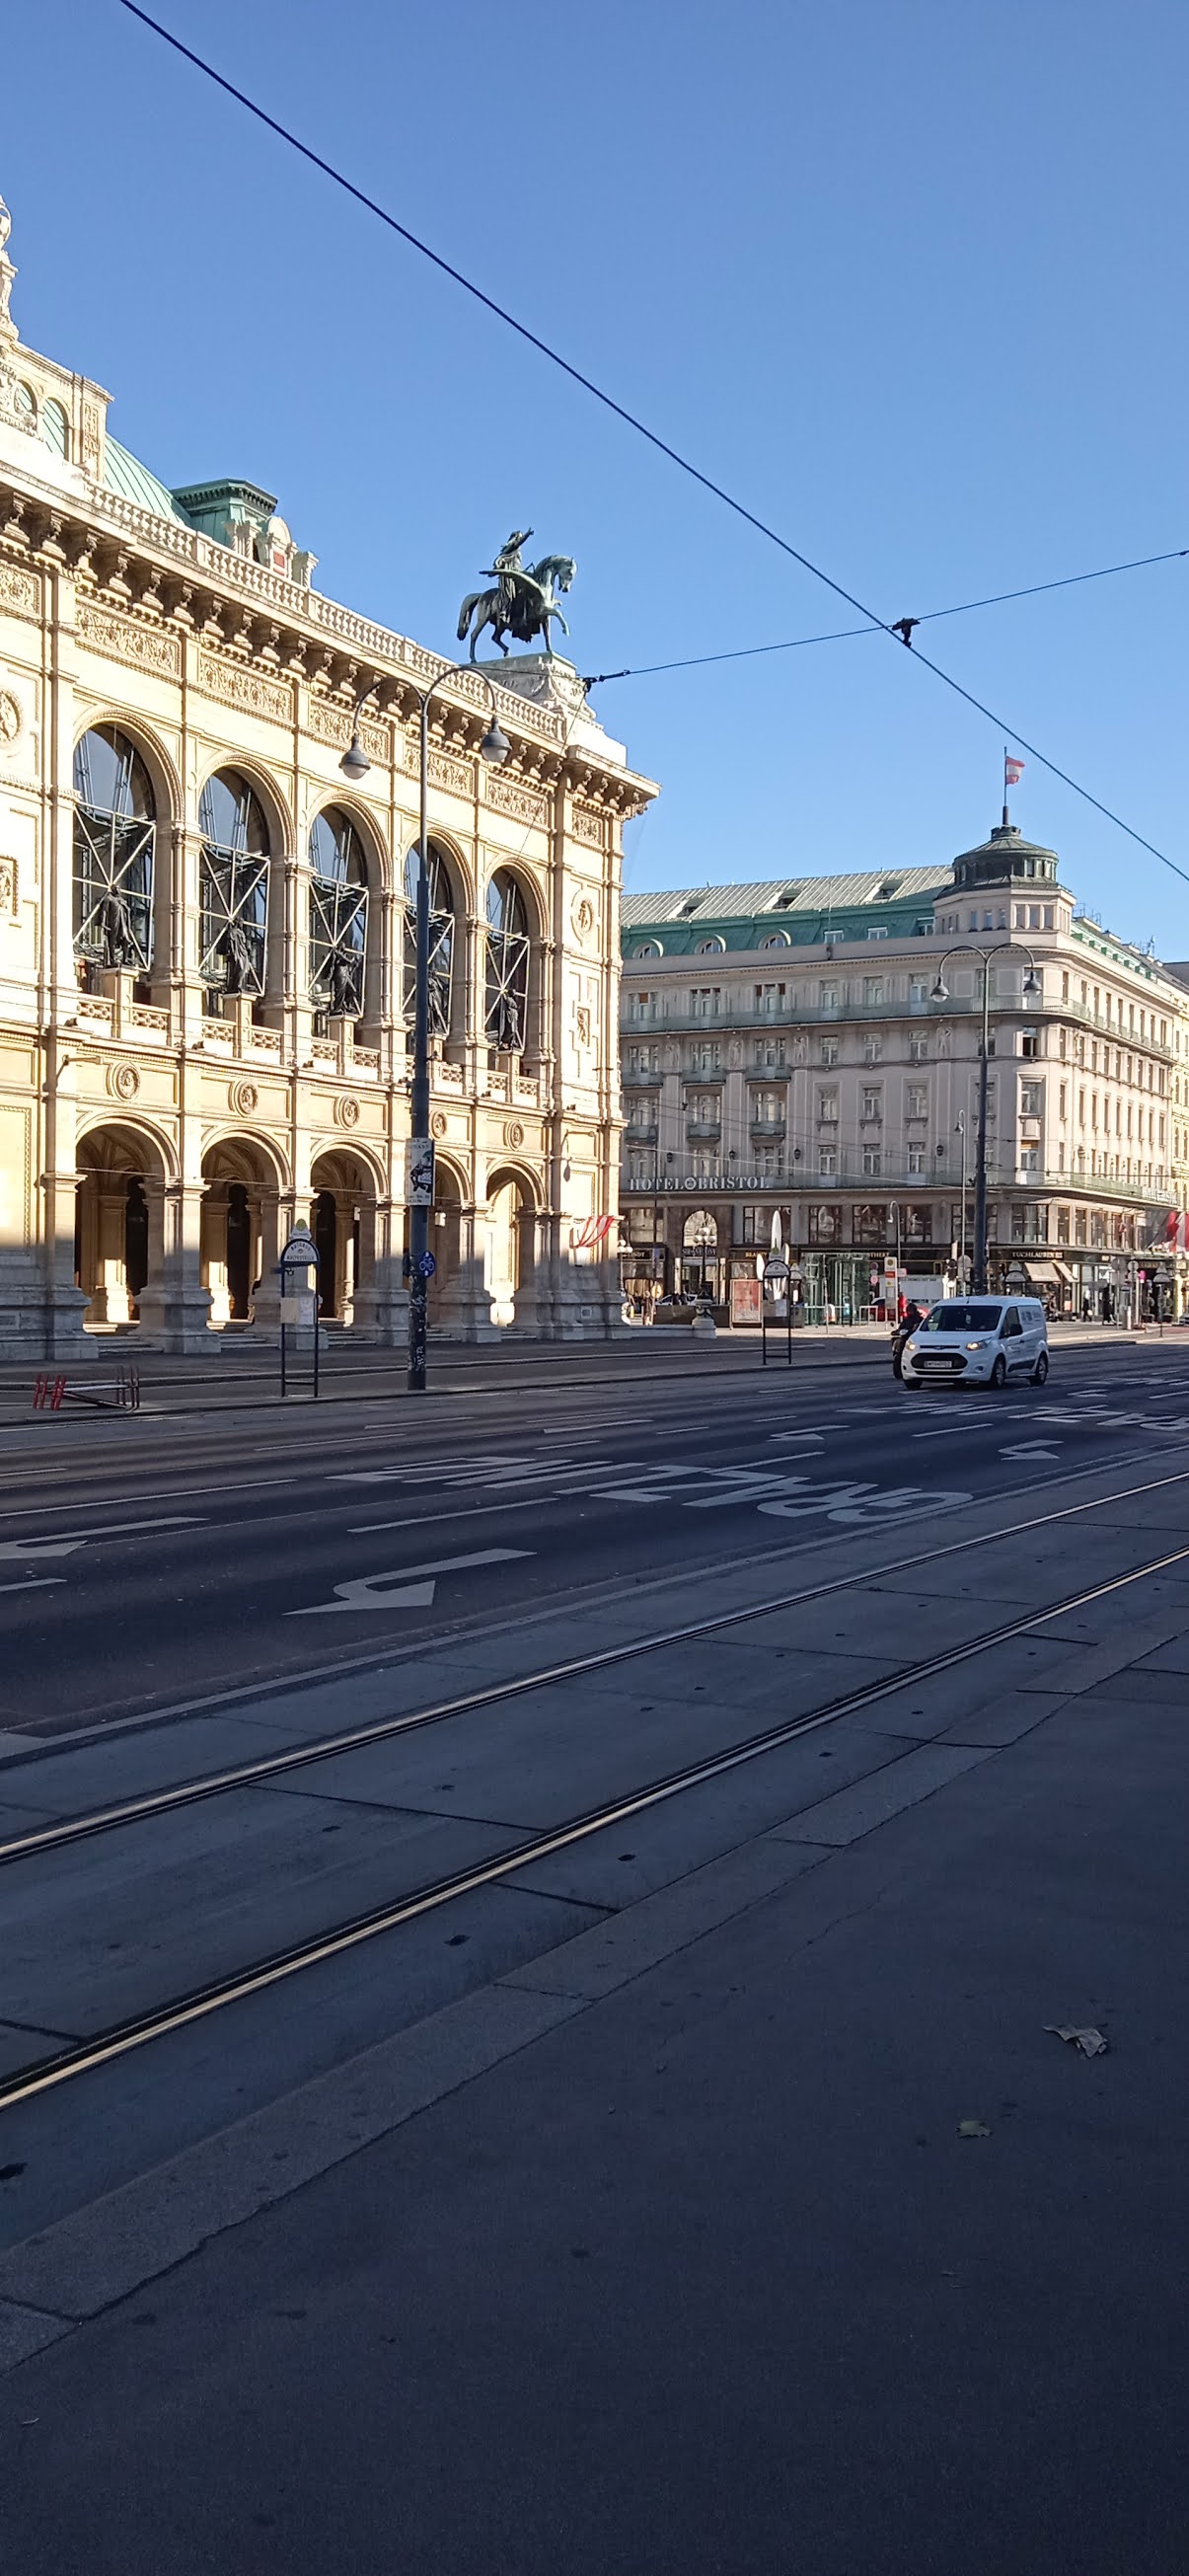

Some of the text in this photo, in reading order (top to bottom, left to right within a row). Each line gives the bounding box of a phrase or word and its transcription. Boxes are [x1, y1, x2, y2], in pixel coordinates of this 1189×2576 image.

[630, 1176, 770, 1190] HOTEL BRISTOL
[324, 1456, 974, 1522] GRAZ LINZ
